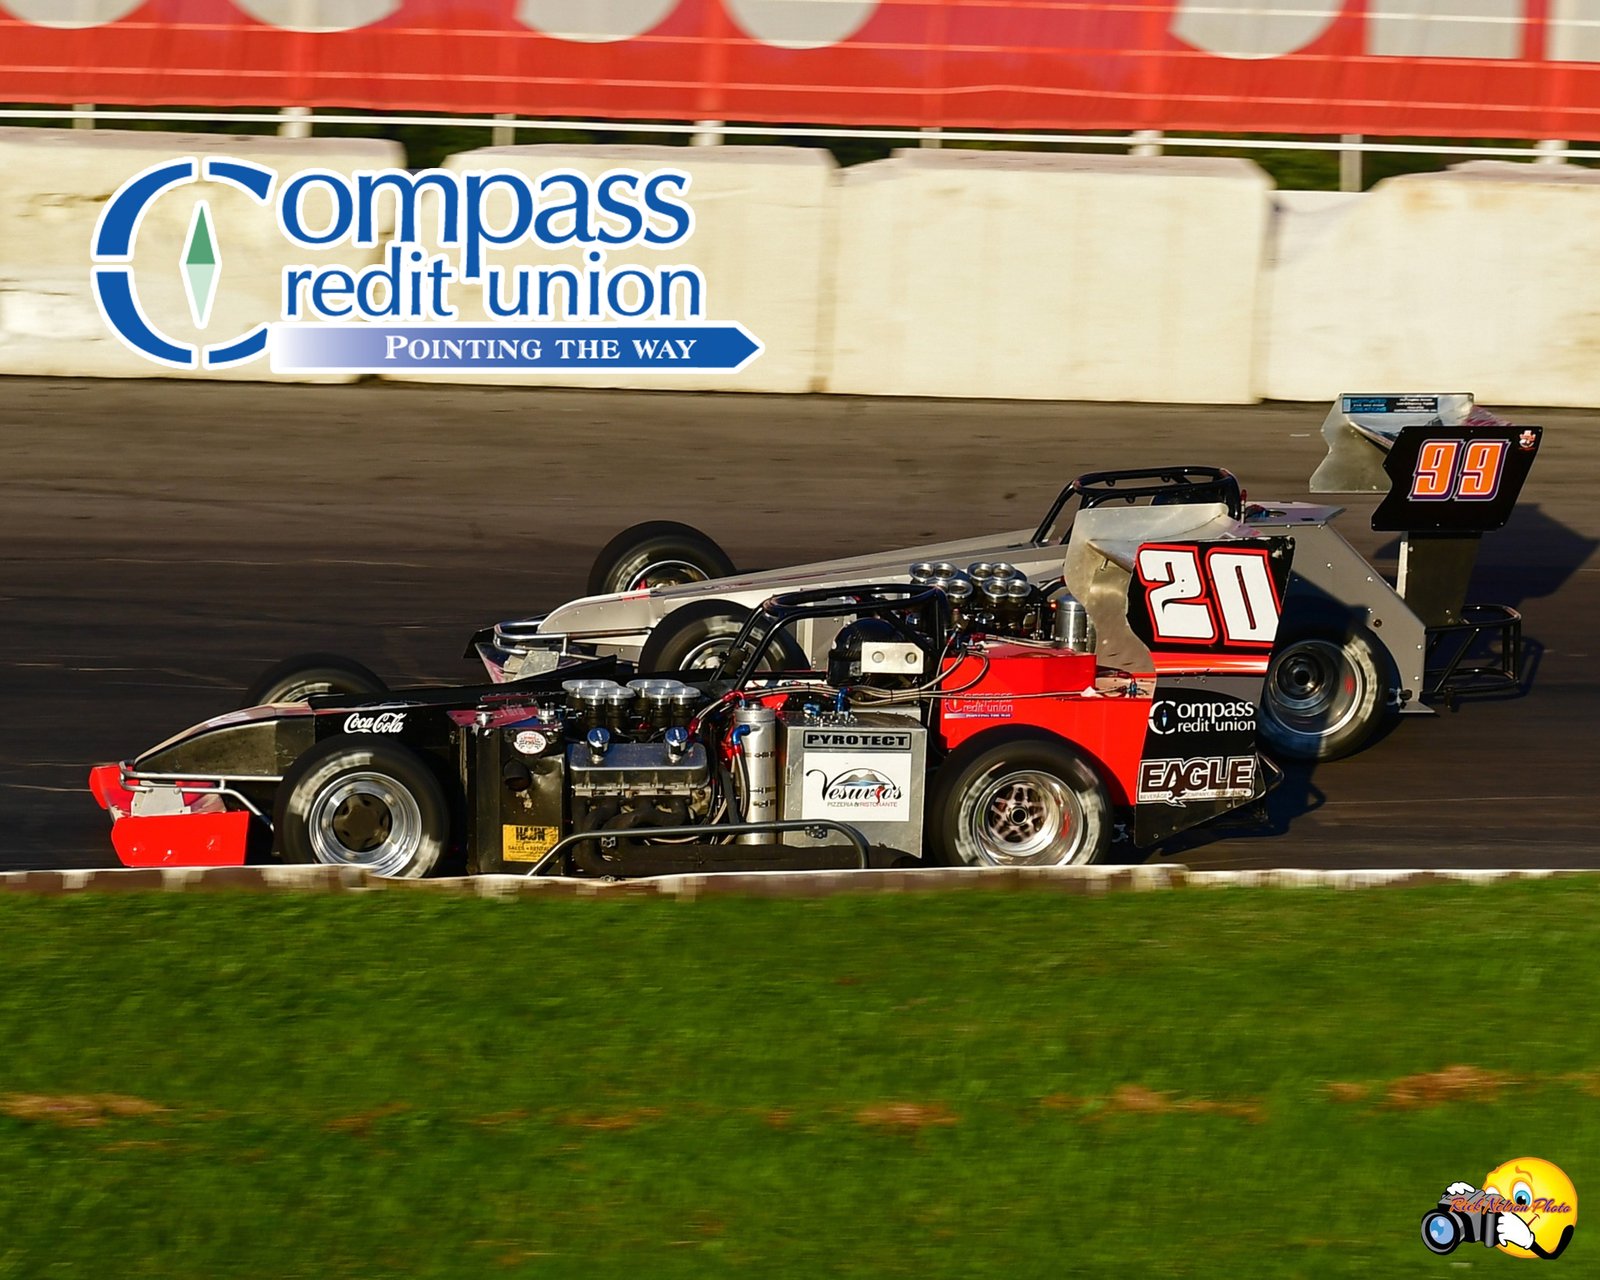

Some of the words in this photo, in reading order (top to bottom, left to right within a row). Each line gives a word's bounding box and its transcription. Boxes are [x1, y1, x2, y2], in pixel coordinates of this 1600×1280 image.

[1407, 438, 1511, 502] 99
[1136, 543, 1282, 648] 20
[807, 735, 908, 746] PYROTECT
[1215, 717, 1256, 732] union
[1139, 757, 1255, 798] EAGLE
